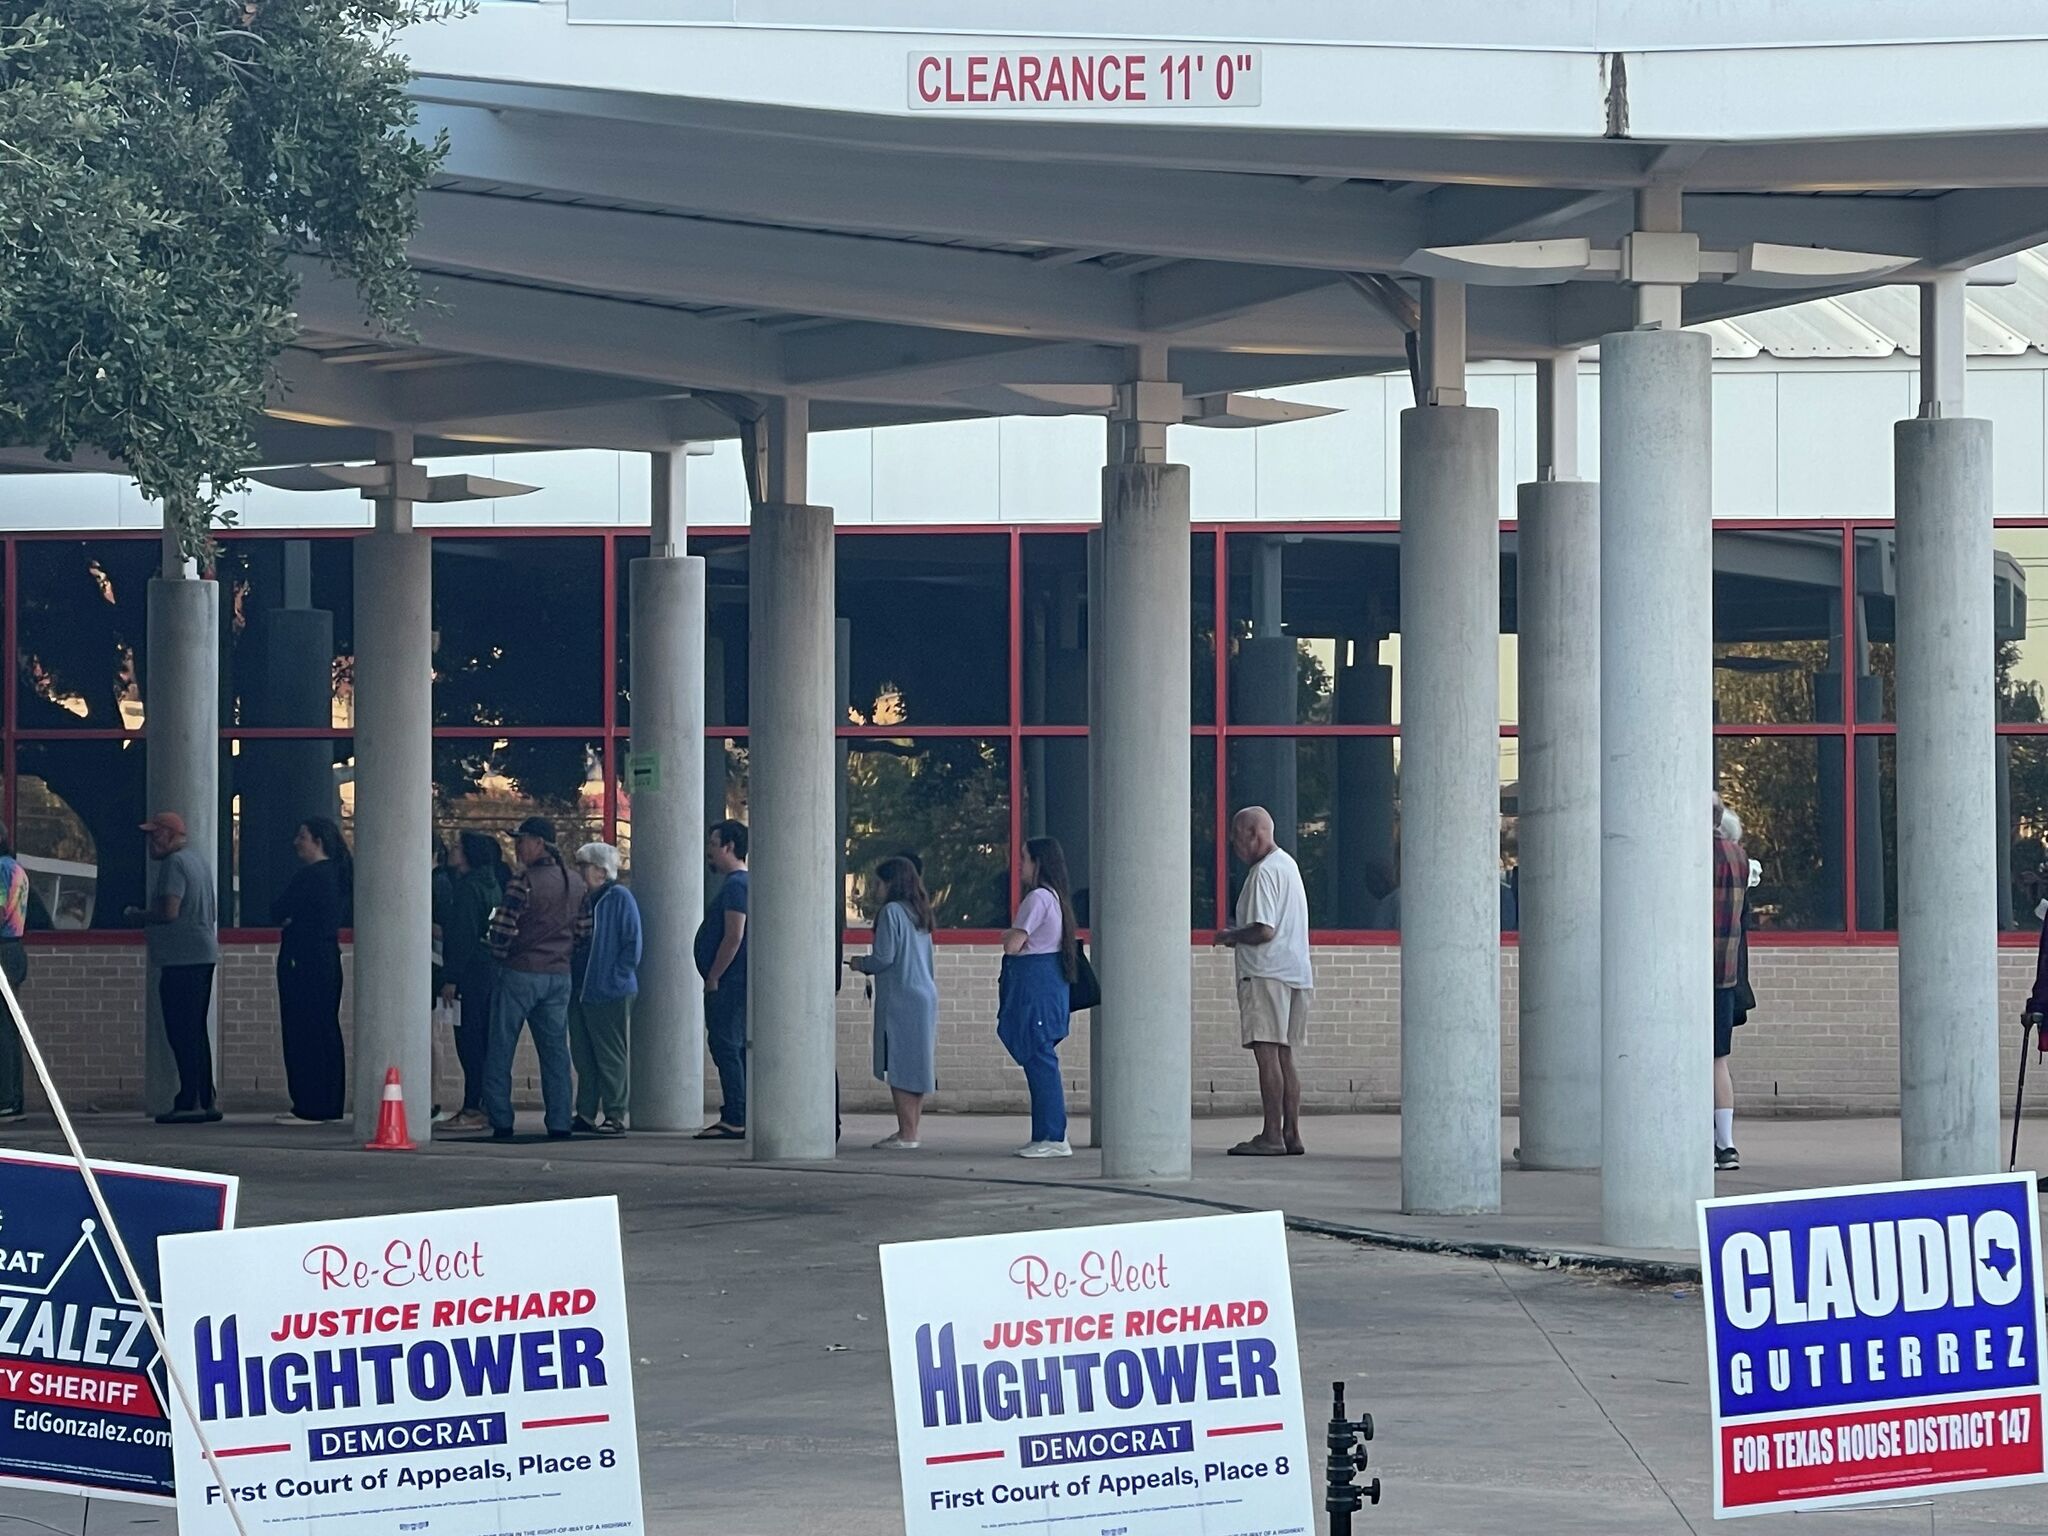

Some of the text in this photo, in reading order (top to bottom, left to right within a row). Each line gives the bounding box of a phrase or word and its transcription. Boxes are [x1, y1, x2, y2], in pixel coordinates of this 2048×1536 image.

[918, 54, 1252, 103] CLEARANCE 11' 0"
[302, 1238, 485, 1290] Re-Elect
[1009, 1250, 1170, 1300] Re-Elect
[1720, 1209, 2023, 1330] CLAUDIO
[271, 1288, 597, 1342] JUSTICE RICHARD
[983, 1300, 1269, 1350] JUSTICE RICHARD
[193, 1313, 609, 1422] HIGHTOWER
[915, 1321, 1281, 1428] HIGHTOWER
[1730, 1326, 2026, 1396] GUTIERREZ
[28, 1372, 139, 1406] SHERIFF
[13, 1408, 172, 1448] EdGonzalez.com
[321, 1418, 493, 1456] DEMOCRAT
[1030, 1426, 1182, 1462] DEMOCRAT
[1733, 1407, 2032, 1475] FOR TEXAS HOUSE DISTRICT 147
[206, 1448, 616, 1505] Frst Court of Appeals, Place 8
[930, 1456, 1290, 1510] First Court of Appeals, Place 8
